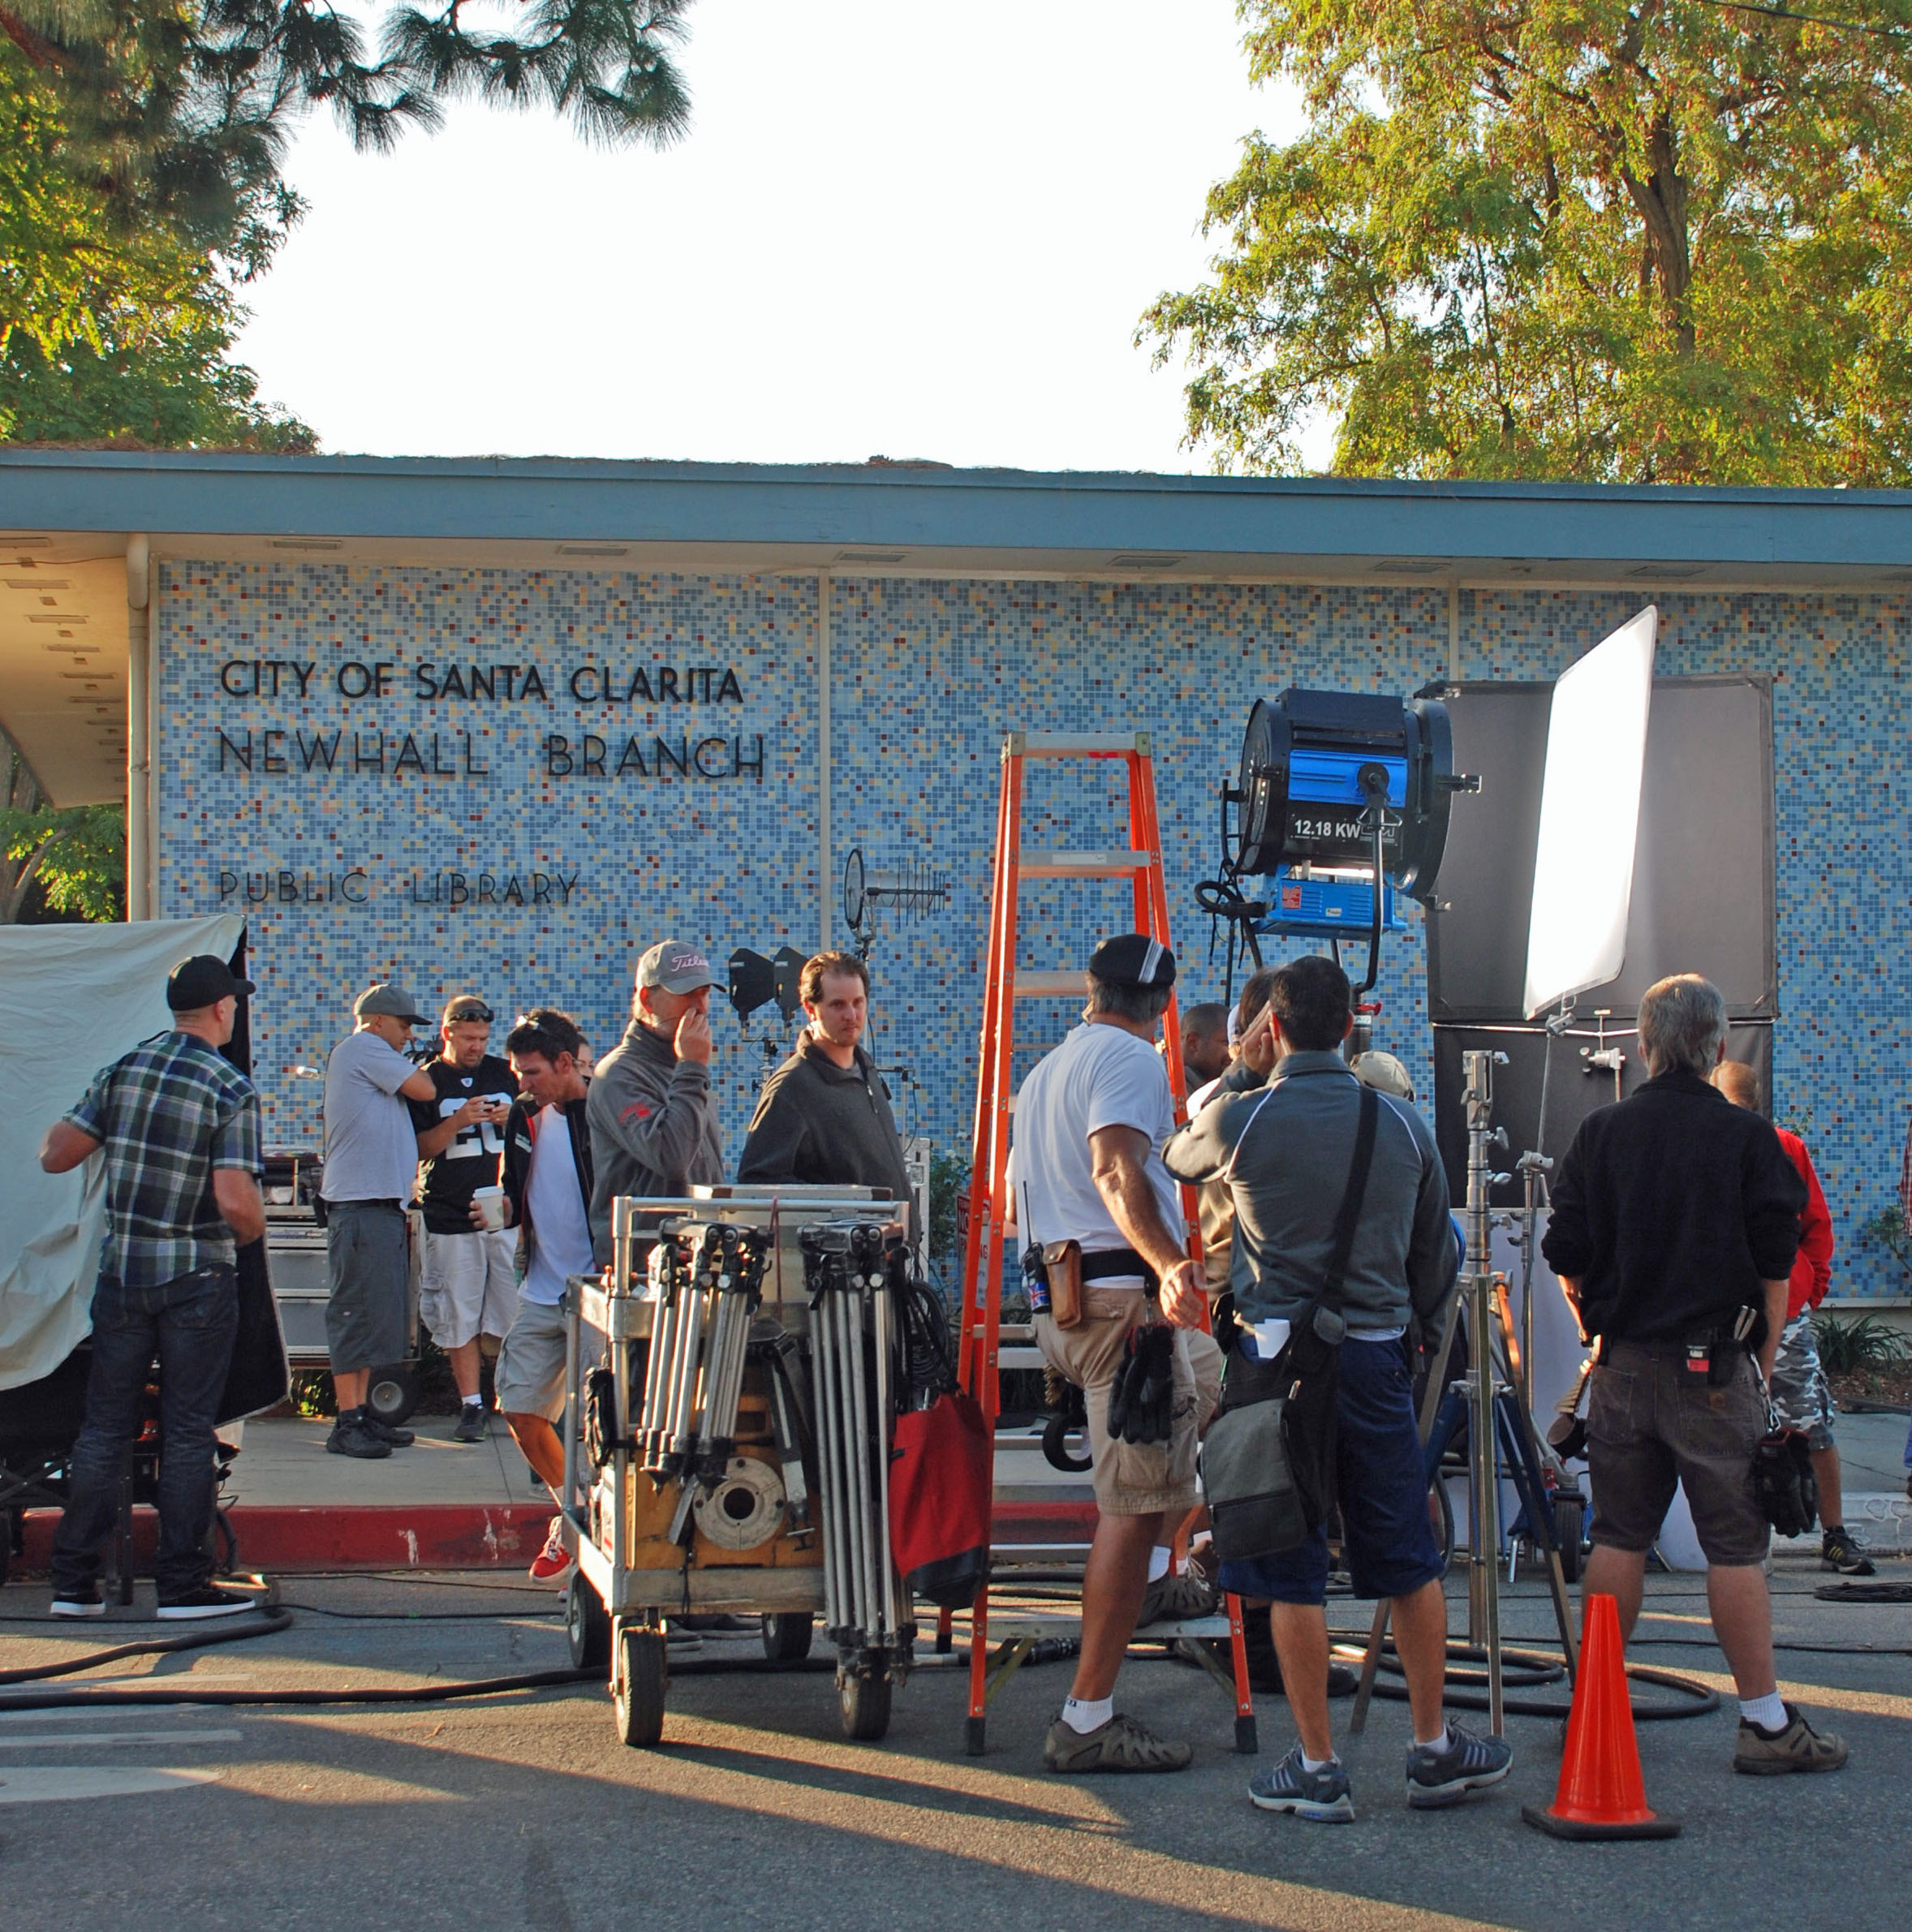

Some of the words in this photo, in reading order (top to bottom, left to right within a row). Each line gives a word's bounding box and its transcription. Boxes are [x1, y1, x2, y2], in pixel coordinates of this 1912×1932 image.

[221, 660, 316, 697] CITY
[338, 661, 394, 699] OF
[416, 663, 548, 700] SANTA
[571, 666, 743, 704] CLARITA
[219, 730, 489, 775] NEWHALL
[548, 734, 764, 778] BRANCH
[1294, 820, 1332, 837] 12.18
[1335, 823, 1361, 839] KW
[220, 871, 368, 902] PUBLIC
[413, 872, 579, 905] LIBRARY
